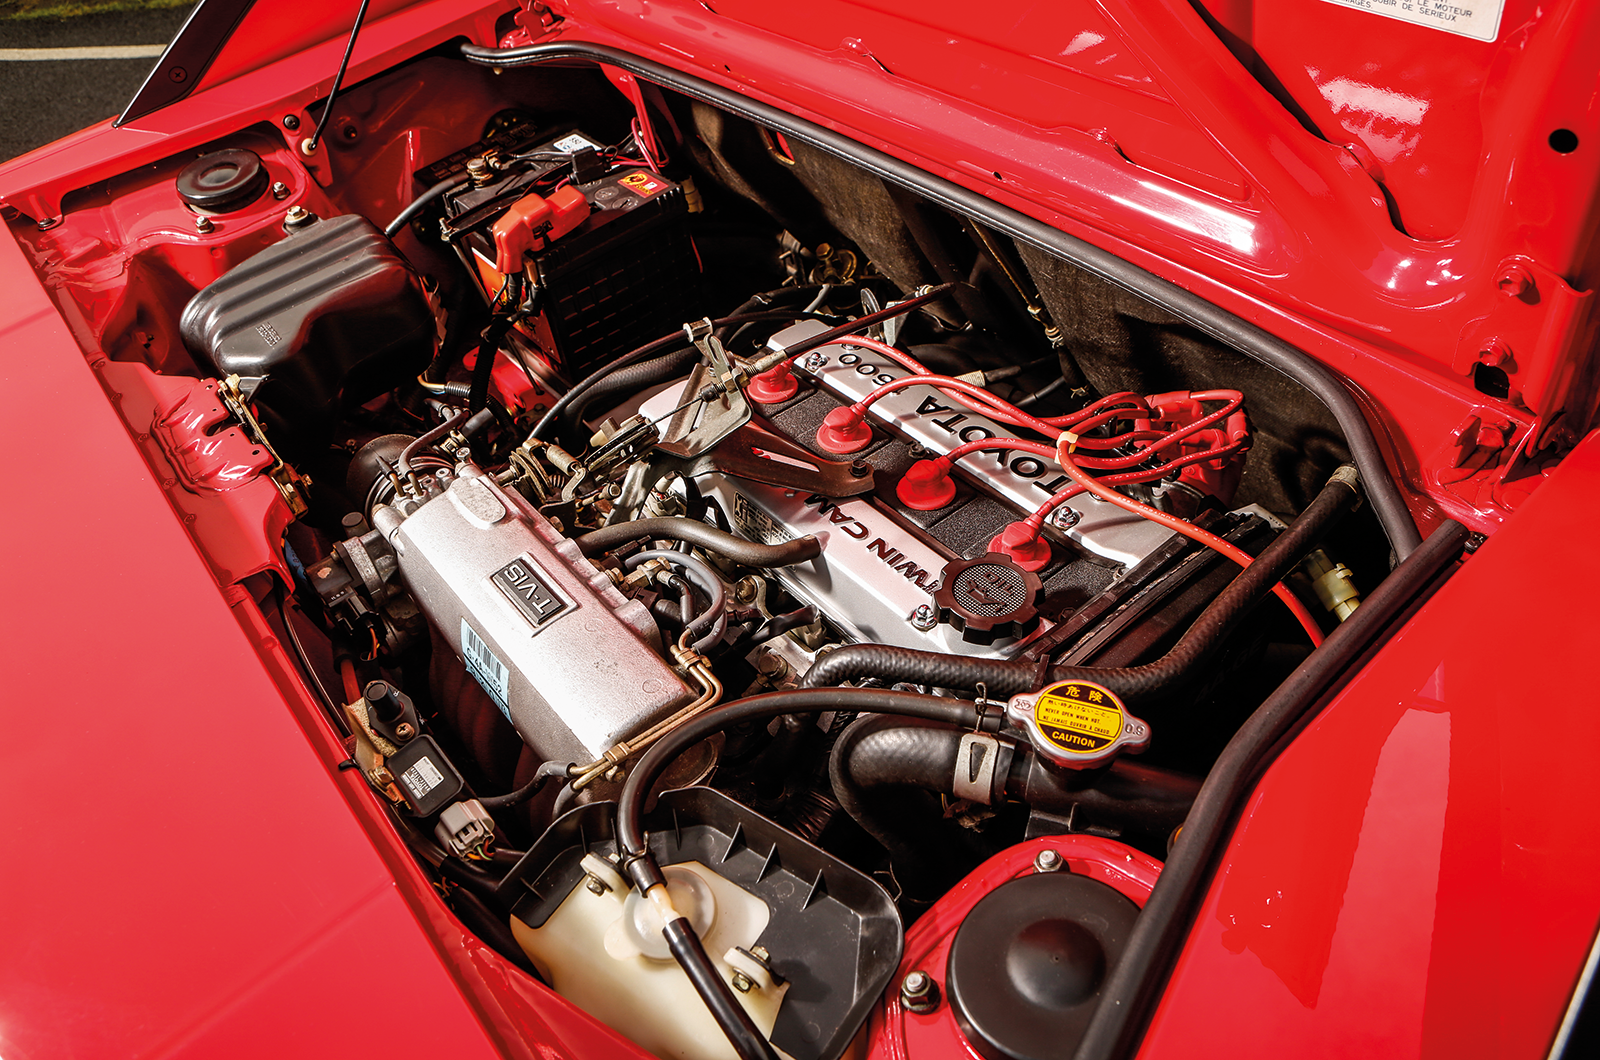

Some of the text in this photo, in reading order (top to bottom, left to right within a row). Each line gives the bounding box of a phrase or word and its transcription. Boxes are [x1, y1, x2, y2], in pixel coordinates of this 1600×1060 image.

[1402, 2, 1413, 11] DE
[1419, 6, 1457, 22] SERIEUX
[1434, 2, 1473, 18] MOTEUR
[803, 493, 869, 540] CAM
[503, 563, 553, 616] T-VIS
[982, 571, 1015, 597] OIL
[1065, 685, 1104, 704] 危険
[1044, 707, 1060, 715] NEVER
[1076, 714, 1089, 722] WHEN
[1051, 730, 1096, 749] CAUTION
